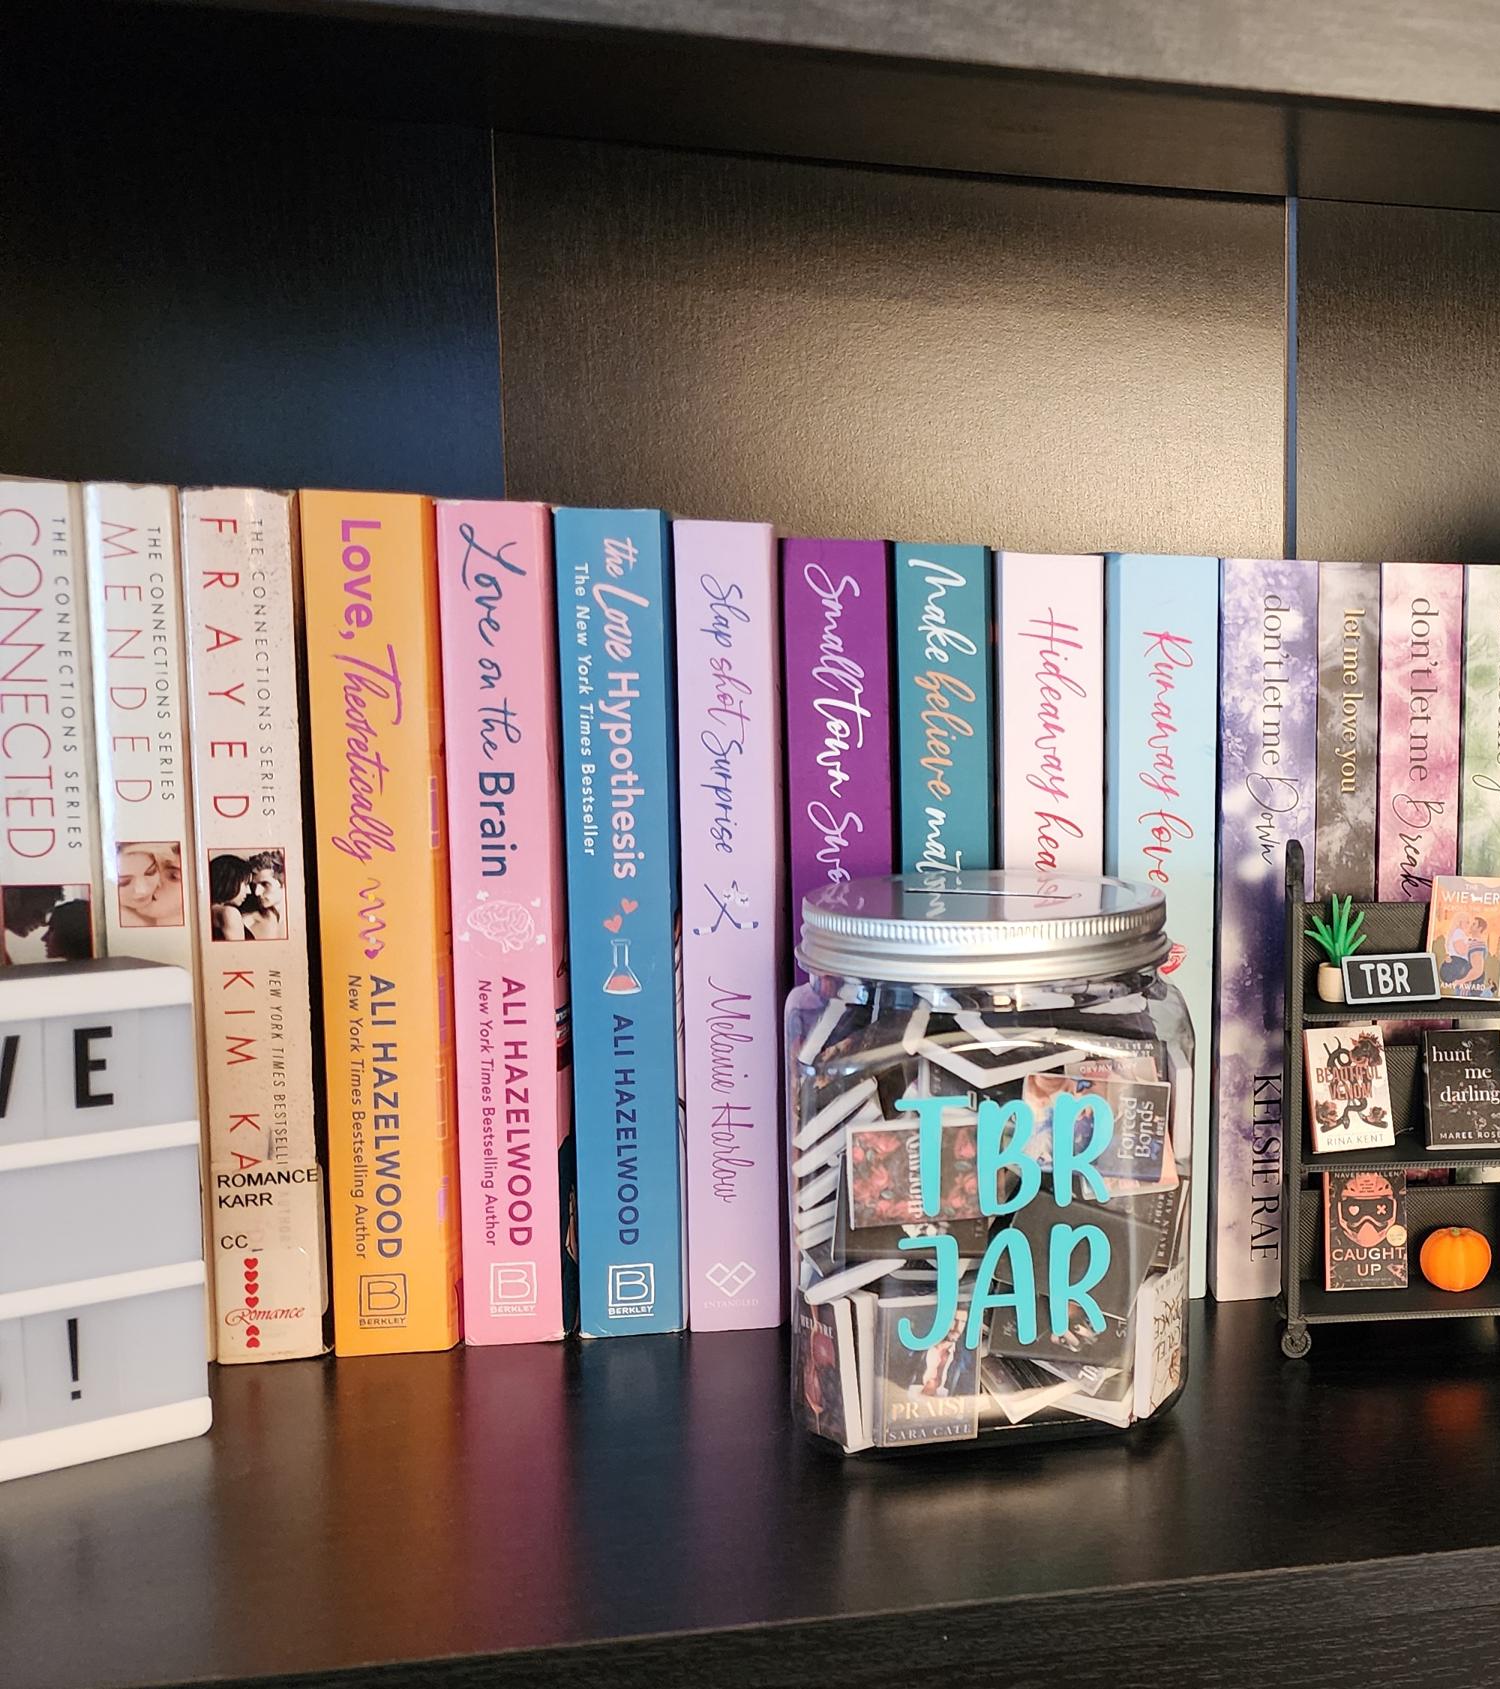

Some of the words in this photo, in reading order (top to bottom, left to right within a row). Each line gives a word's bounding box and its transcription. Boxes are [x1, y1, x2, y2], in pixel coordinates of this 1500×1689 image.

[51, 517, 67, 557] THE
[147, 526, 163, 561] THE
[249, 519, 264, 555] THE
[602, 536, 638, 578] the
[337, 519, 382, 642] Love,
[459, 522, 528, 647] Love
[574, 563, 586, 597] The
[576, 605, 588, 645] New
[592, 582, 650, 663] Love
[700, 574, 751, 649] Slap
[908, 558, 977, 663] Make
[1343, 608, 1366, 640] let
[54, 575, 78, 753] CONNECTIONS
[100, 520, 153, 804] MENDED
[149, 572, 171, 720] CONNECTIONS
[200, 516, 250, 820] FRAYED
[250, 570, 272, 731] CONNECTIONS
[578, 650, 594, 696] York
[1341, 644, 1359, 686] me
[0, 508, 56, 859] CONNECTED
[479, 656, 503, 691] on
[708, 656, 752, 742] shot
[1262, 673, 1290, 715] let
[479, 697, 522, 761] the
[579, 703, 592, 757] Times
[1017, 606, 1087, 804] Hideaway
[1138, 630, 1194, 801] Runaway
[1341, 692, 1364, 744] love
[1409, 684, 1438, 725] let
[330, 643, 404, 867] Theoretically
[914, 670, 976, 801] believe
[1261, 720, 1281, 768] me
[1408, 730, 1428, 783] me
[158, 731, 176, 801] SERIES
[259, 745, 276, 818] SERIES
[599, 672, 645, 880] Hypothesis
[701, 730, 743, 855] Surprise
[1334, 745, 1358, 796] you
[64, 770, 82, 850] SERIES
[478, 770, 519, 878] Brain
[581, 763, 598, 857] Bestseller
[1245, 772, 1300, 866] Down
[806, 801, 864, 884] Swo
[915, 806, 963, 875] mat
[1034, 810, 1085, 873] hea
[1137, 809, 1194, 885] love
[1392, 793, 1446, 898] Break
[267, 969, 282, 997] NEW
[347, 974, 361, 1013] New
[370, 974, 396, 1028] ALI
[478, 979, 492, 1013] New
[501, 976, 527, 1026] ALI
[1359, 962, 1412, 995] TBR
[1440, 981, 1456, 989] AMY
[1459, 983, 1486, 992] AWARD
[221, 970, 257, 1066] KIM
[269, 1004, 283, 1039] YORK
[349, 1017, 363, 1052] York
[479, 1017, 494, 1053] York
[612, 1014, 635, 1057] ALI
[705, 975, 753, 1096] Melanie
[271, 1047, 286, 1087] TIMES
[350, 1058, 362, 1105] Times
[480, 1059, 492, 1102] Times
[1315, 1065, 1382, 1084] BEAUTIFUL
[1432, 1046, 1473, 1063] hunt
[1464, 1065, 1493, 1080] me
[1328, 1082, 1374, 1101] VENOM
[1440, 1085, 1500, 1105] darling
[273, 1093, 289, 1165] BESTSELLI
[351, 1110, 366, 1199] Bestselling
[372, 1042, 403, 1259] HAZELWOOD
[481, 1107, 497, 1190] Bestselling
[504, 1040, 533, 1247] HAZELWOOD
[711, 1102, 755, 1204] Harlow
[894, 1092, 1115, 1217] TBR
[1116, 1096, 1138, 1160] Forced
[1134, 1100, 1155, 1159] Bonds
[1251, 1071, 1283, 1187] KELSIE
[1326, 1136, 1353, 1147] RINA
[1354, 1133, 1385, 1145] KENT
[1440, 1131, 1474, 1140] MAREE
[217, 1168, 319, 1189] ROMANCE
[615, 1069, 640, 1246] HAZELWOOD
[218, 1192, 273, 1209] KARR
[485, 1194, 497, 1247] Author
[220, 1234, 249, 1250] CC
[354, 1204, 367, 1260] Author
[1249, 1198, 1281, 1263] RAE
[1332, 1247, 1406, 1261] CAUGHT
[898, 1223, 1111, 1351] JAR
[1357, 1263, 1382, 1276] UP
[224, 1306, 305, 1326] Romance
[358, 1316, 407, 1327] BERKLEY
[490, 1304, 536, 1314] BERKLEY
[608, 1305, 654, 1315] BERKLEY
[703, 1299, 759, 1309] ENTANGLED
[67, 1318, 82, 1400] !
[888, 1429, 927, 1442] SARA
[933, 1423, 972, 1436] CATE
